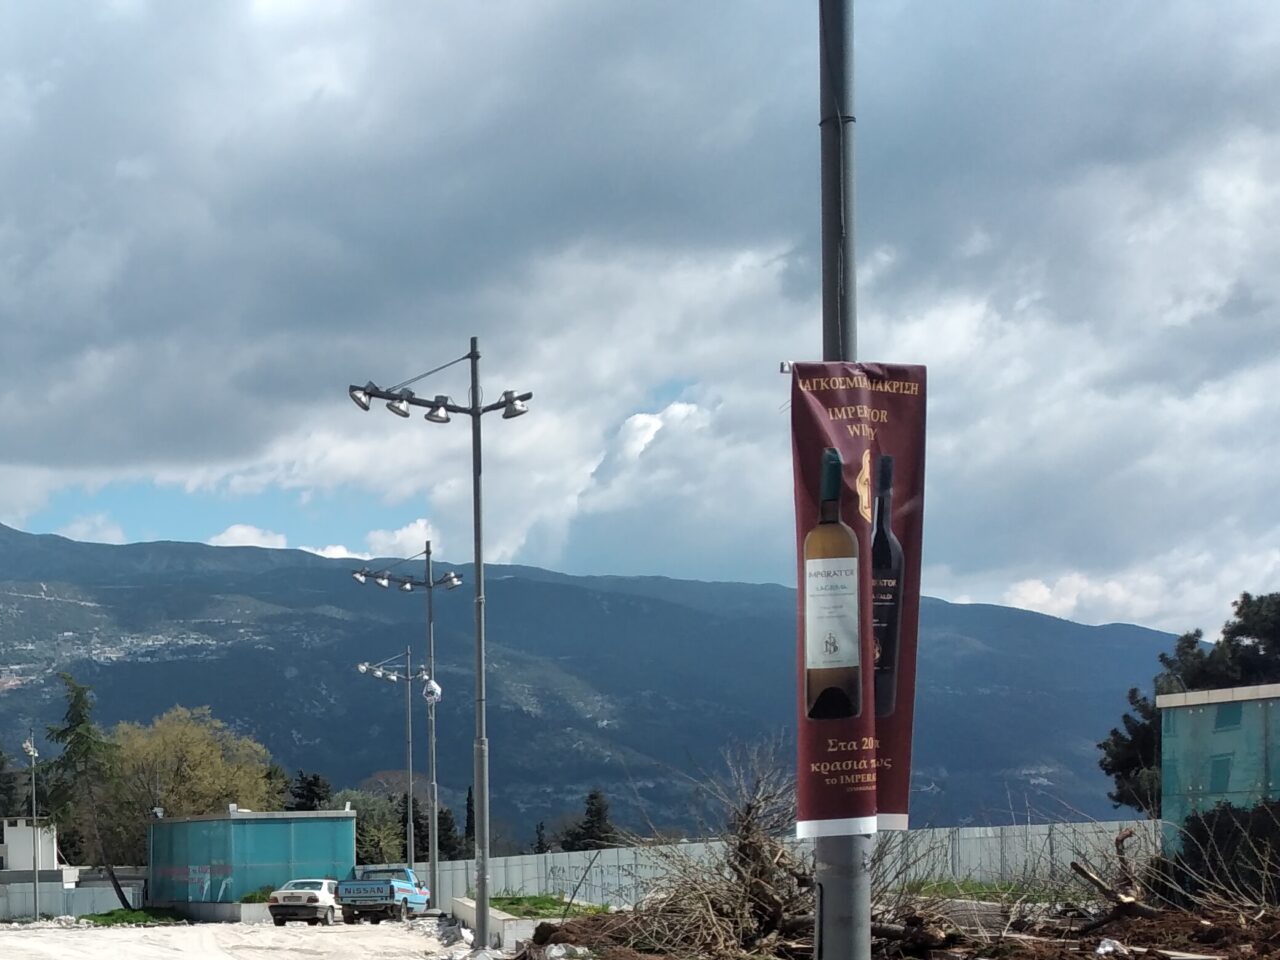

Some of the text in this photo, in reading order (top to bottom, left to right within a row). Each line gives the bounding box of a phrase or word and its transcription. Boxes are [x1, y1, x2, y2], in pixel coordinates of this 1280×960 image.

[827, 738, 858, 752] Στα
[811, 757, 867, 774] κρασιά
[344, 886, 384, 894] NISSAN
